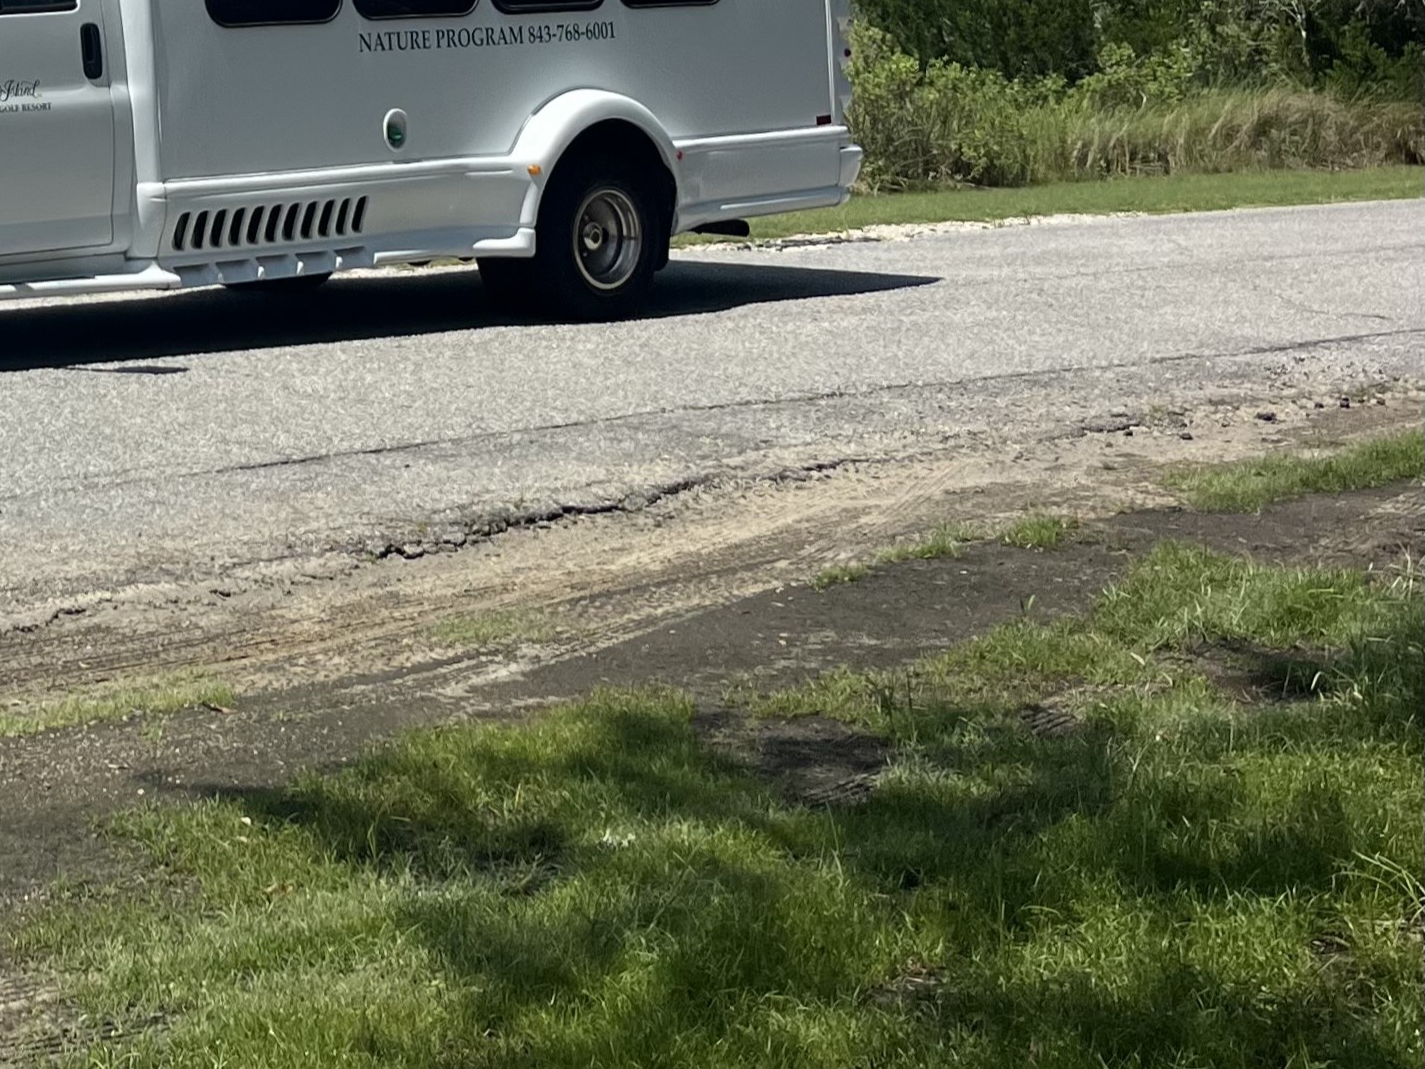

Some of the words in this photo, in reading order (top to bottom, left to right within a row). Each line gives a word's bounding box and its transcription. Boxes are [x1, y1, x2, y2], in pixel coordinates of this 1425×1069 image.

[359, 30, 431, 53] NATURE
[436, 26, 524, 49] PROGRAM
[527, 21, 616, 44] 843-768-6001
[1, 79, 41, 102] Island
[21, 102, 53, 112] RESORT
